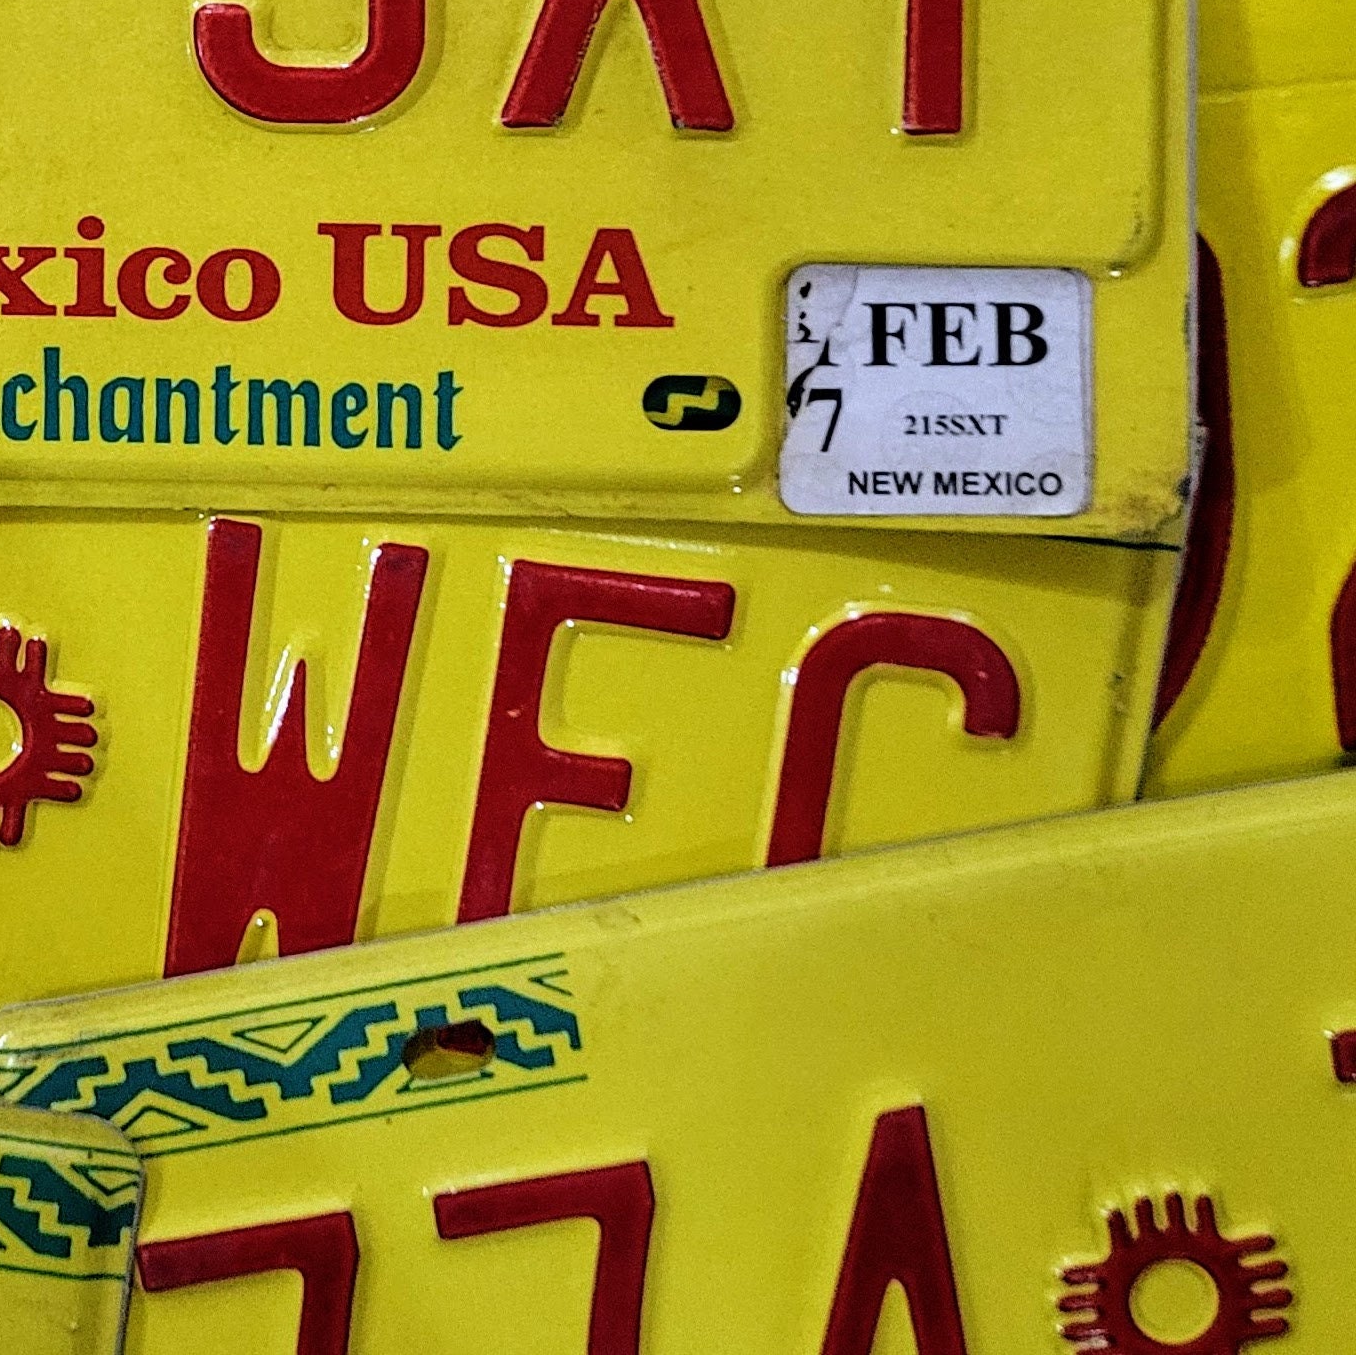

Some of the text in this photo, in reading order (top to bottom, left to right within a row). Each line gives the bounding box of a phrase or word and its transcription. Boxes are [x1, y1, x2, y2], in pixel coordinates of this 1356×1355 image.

[318, 223, 674, 327] USA
[863, 302, 1049, 367] FEB
[904, 414, 1008, 436] 215SXT
[848, 471, 1063, 497] NEW MEXICO
